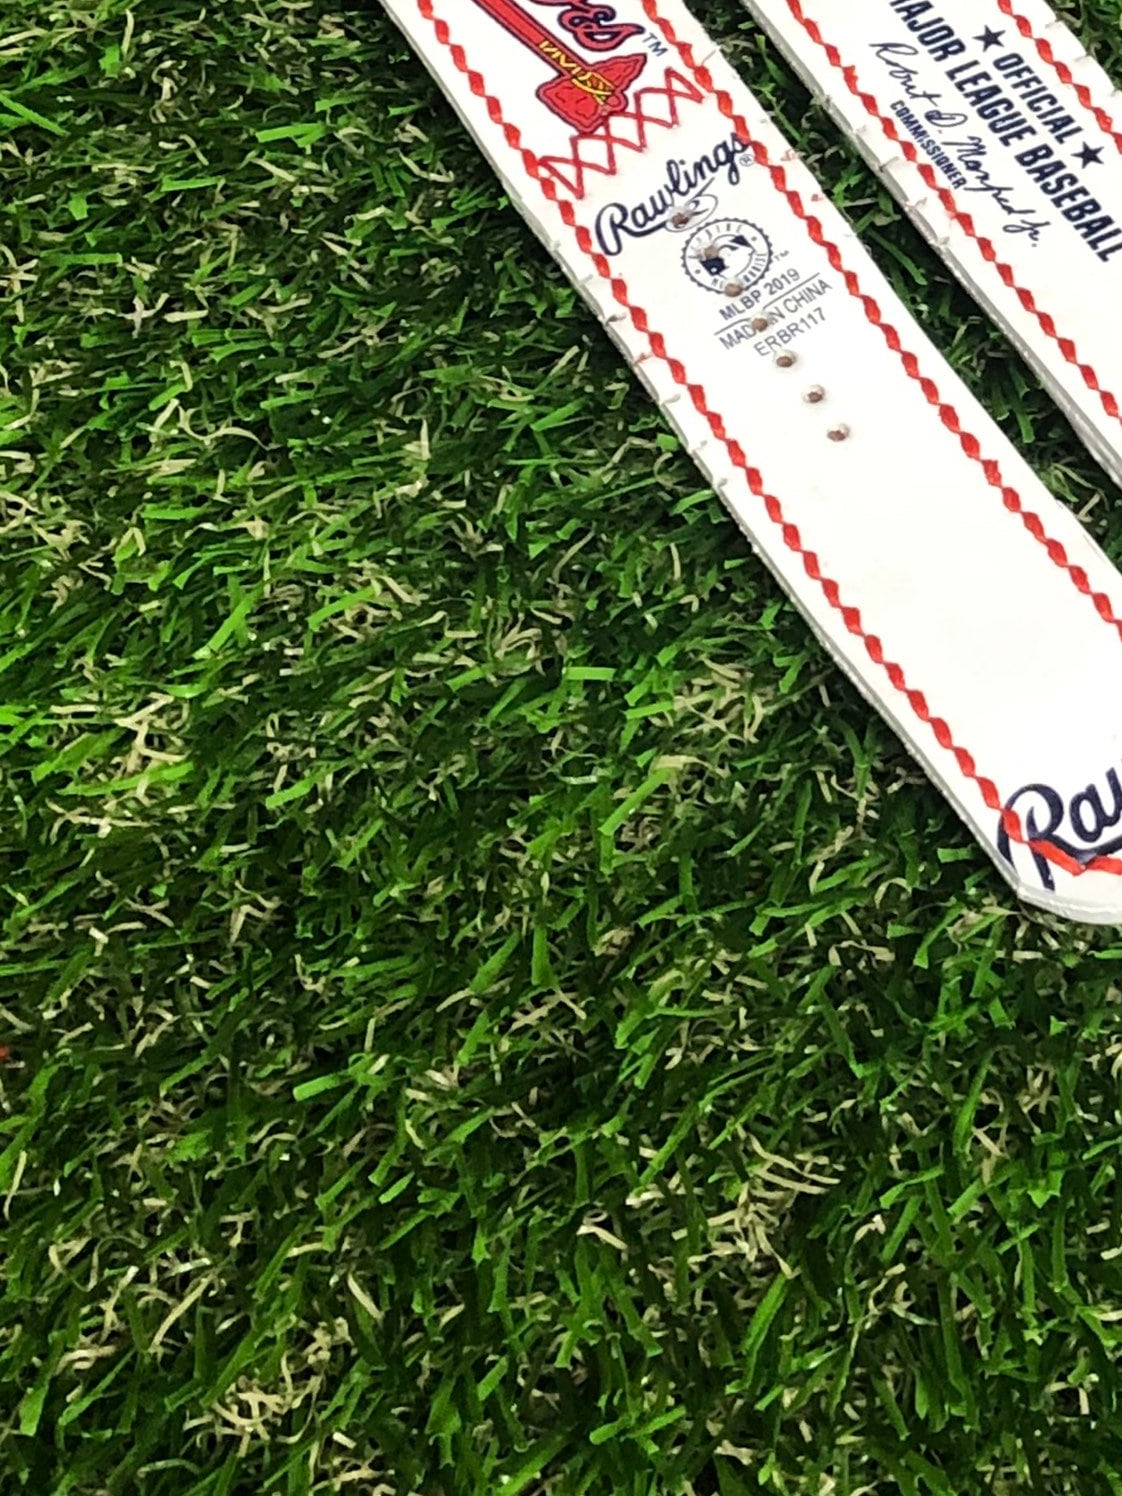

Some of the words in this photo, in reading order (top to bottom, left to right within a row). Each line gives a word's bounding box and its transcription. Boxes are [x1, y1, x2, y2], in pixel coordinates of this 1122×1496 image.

[945, 59, 1037, 147] LEAGUE
[992, 53, 1084, 145] OFFICIAL
[889, 99, 967, 190] COMMISSIONER
[595, 132, 750, 256] Rawlings
[719, 289, 762, 321] MLBP
[764, 268, 800, 296] 2019
[719, 319, 766, 350] MAD
[782, 278, 833, 314] CHINA
[753, 307, 826, 357] ERBR117
